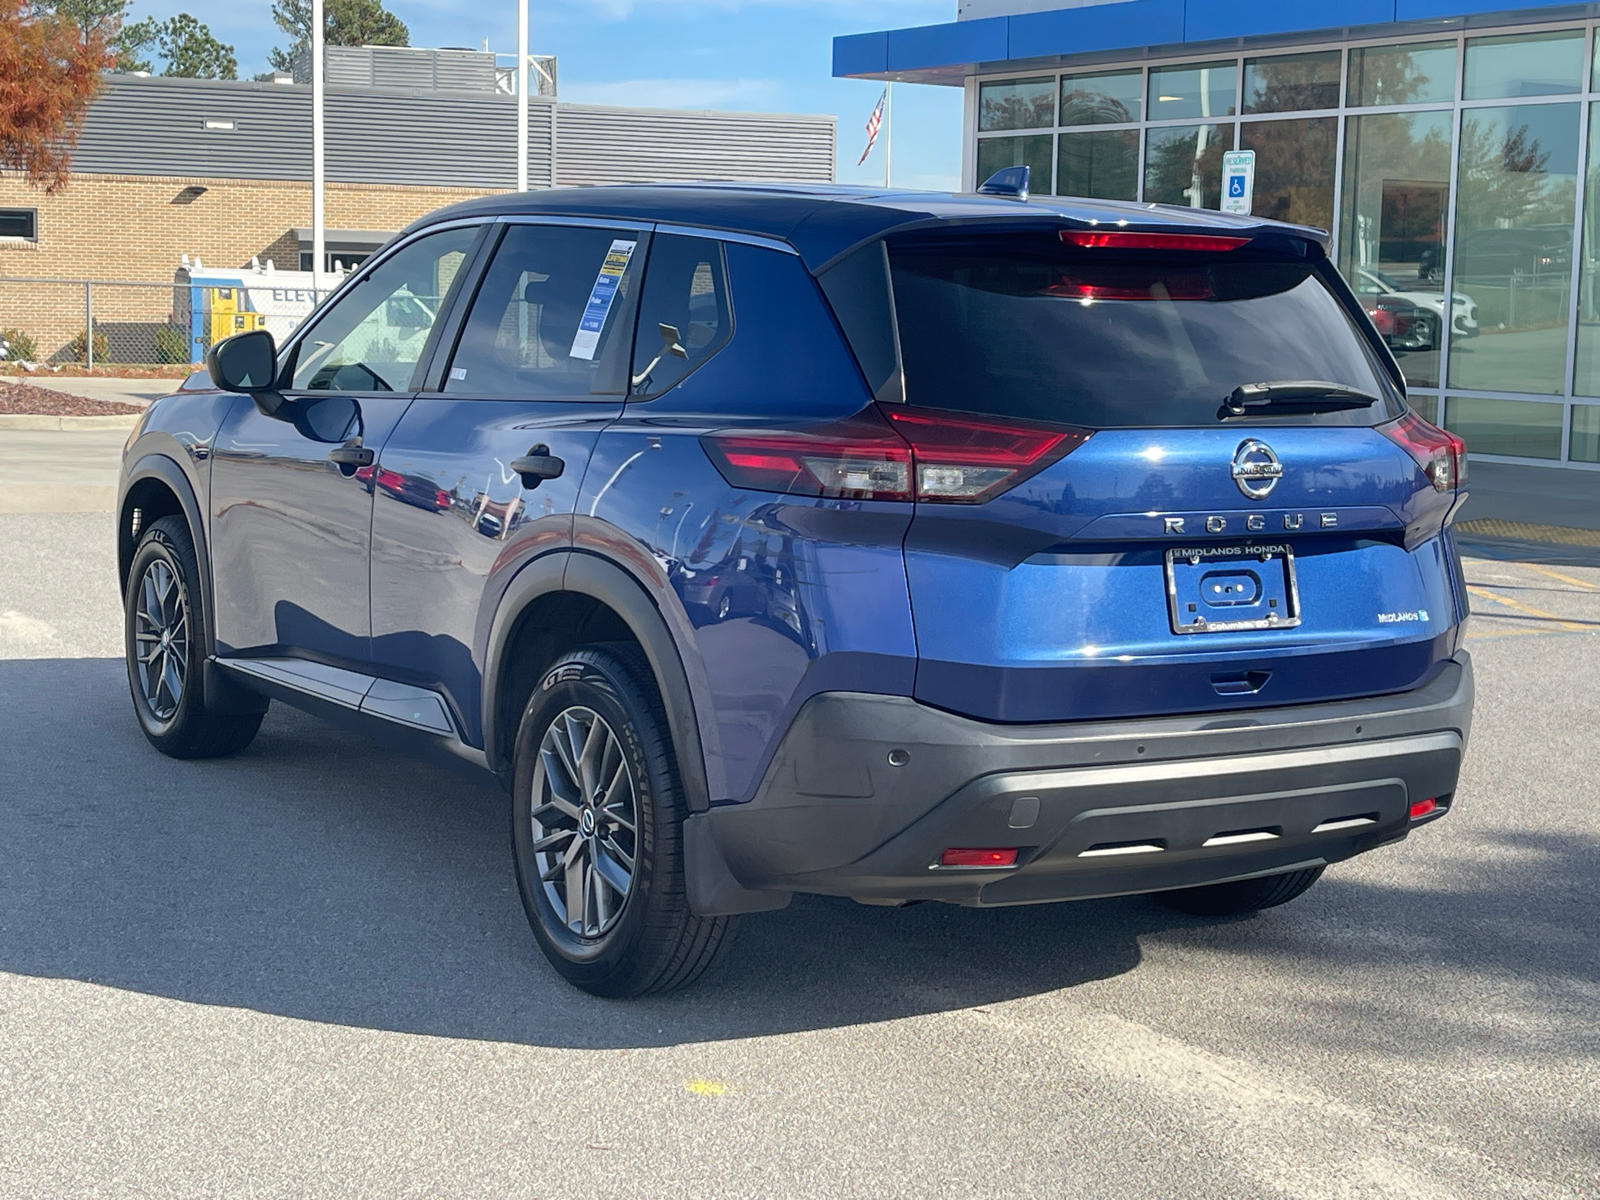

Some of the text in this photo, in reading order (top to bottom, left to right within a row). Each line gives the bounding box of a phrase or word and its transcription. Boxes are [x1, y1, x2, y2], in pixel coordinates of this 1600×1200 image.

[1226, 157, 1252, 165] RESERVED
[1240, 463, 1281, 475] NISSAN
[1164, 512, 1338, 534] ROGUE
[1182, 545, 1286, 557] MIDLANDS HONDA
[1377, 611, 1419, 623] MIDLANDS
[542, 664, 585, 691] GT
